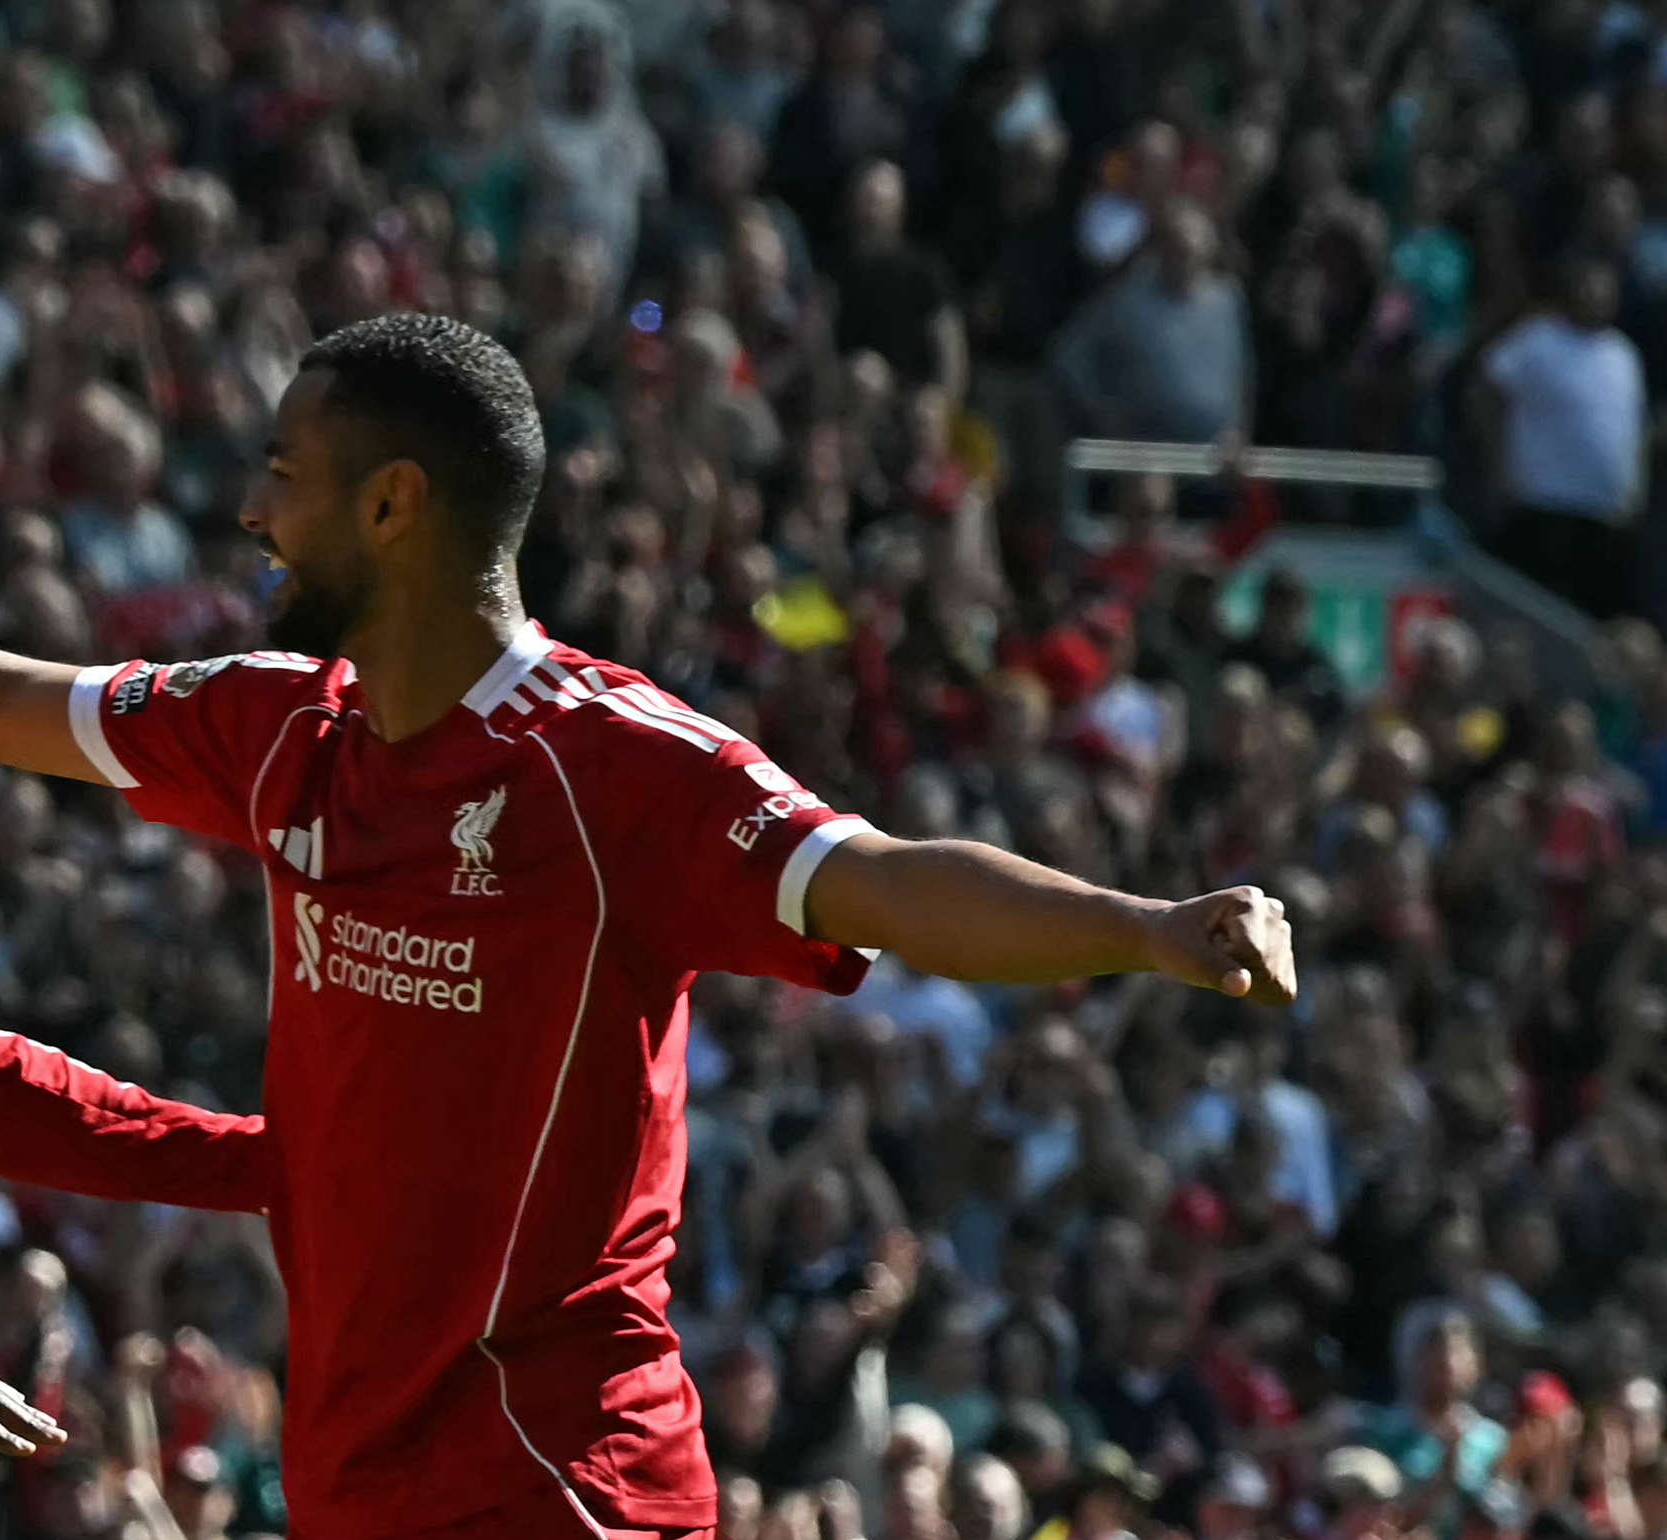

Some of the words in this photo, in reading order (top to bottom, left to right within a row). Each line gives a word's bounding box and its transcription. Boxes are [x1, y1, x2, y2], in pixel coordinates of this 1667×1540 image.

[450, 873, 503, 896] L.F.C.
[331, 911, 475, 973] standard
[327, 951, 483, 1014] chartered
